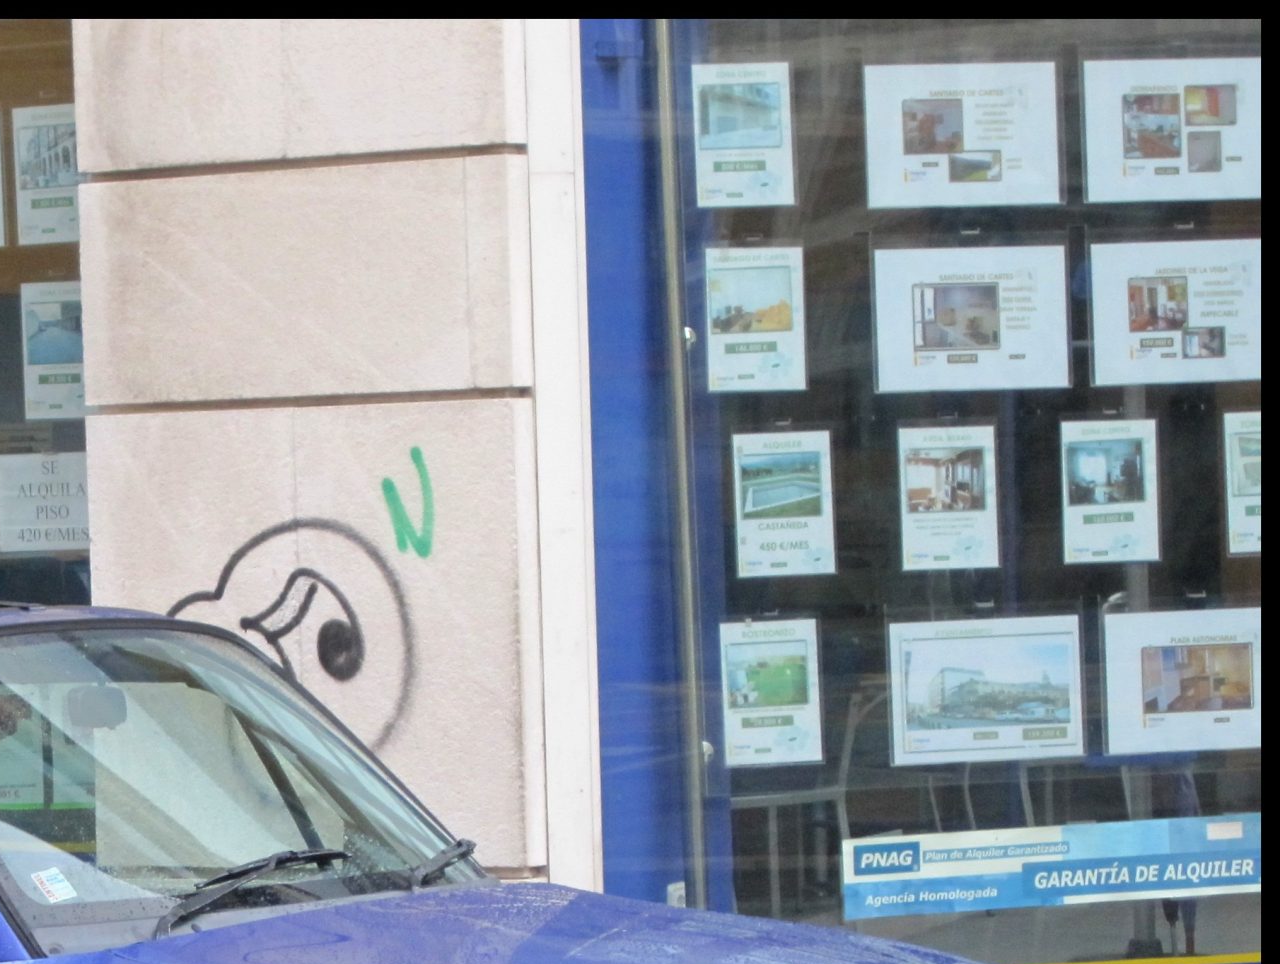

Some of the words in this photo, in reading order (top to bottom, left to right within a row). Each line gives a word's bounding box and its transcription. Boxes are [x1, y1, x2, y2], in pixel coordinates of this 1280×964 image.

[41, 461, 58, 475] SE
[18, 482, 87, 499] ALQUILA
[35, 504, 70, 520] PISO
[18, 528, 41, 542] 420
[760, 542, 776, 551] 450
[861, 850, 913, 869] PNAG
[924, 850, 947, 861] Plan
[949, 850, 963, 859] de
[966, 848, 1004, 860] Alquiler
[1007, 843, 1068, 856] Garantizado
[1034, 862, 1130, 889] GARANTÍA
[1135, 865, 1159, 882] DE
[1164, 859, 1254, 883] ALQUILER
[865, 892, 915, 907] Agencia
[920, 887, 998, 902] Homologada
